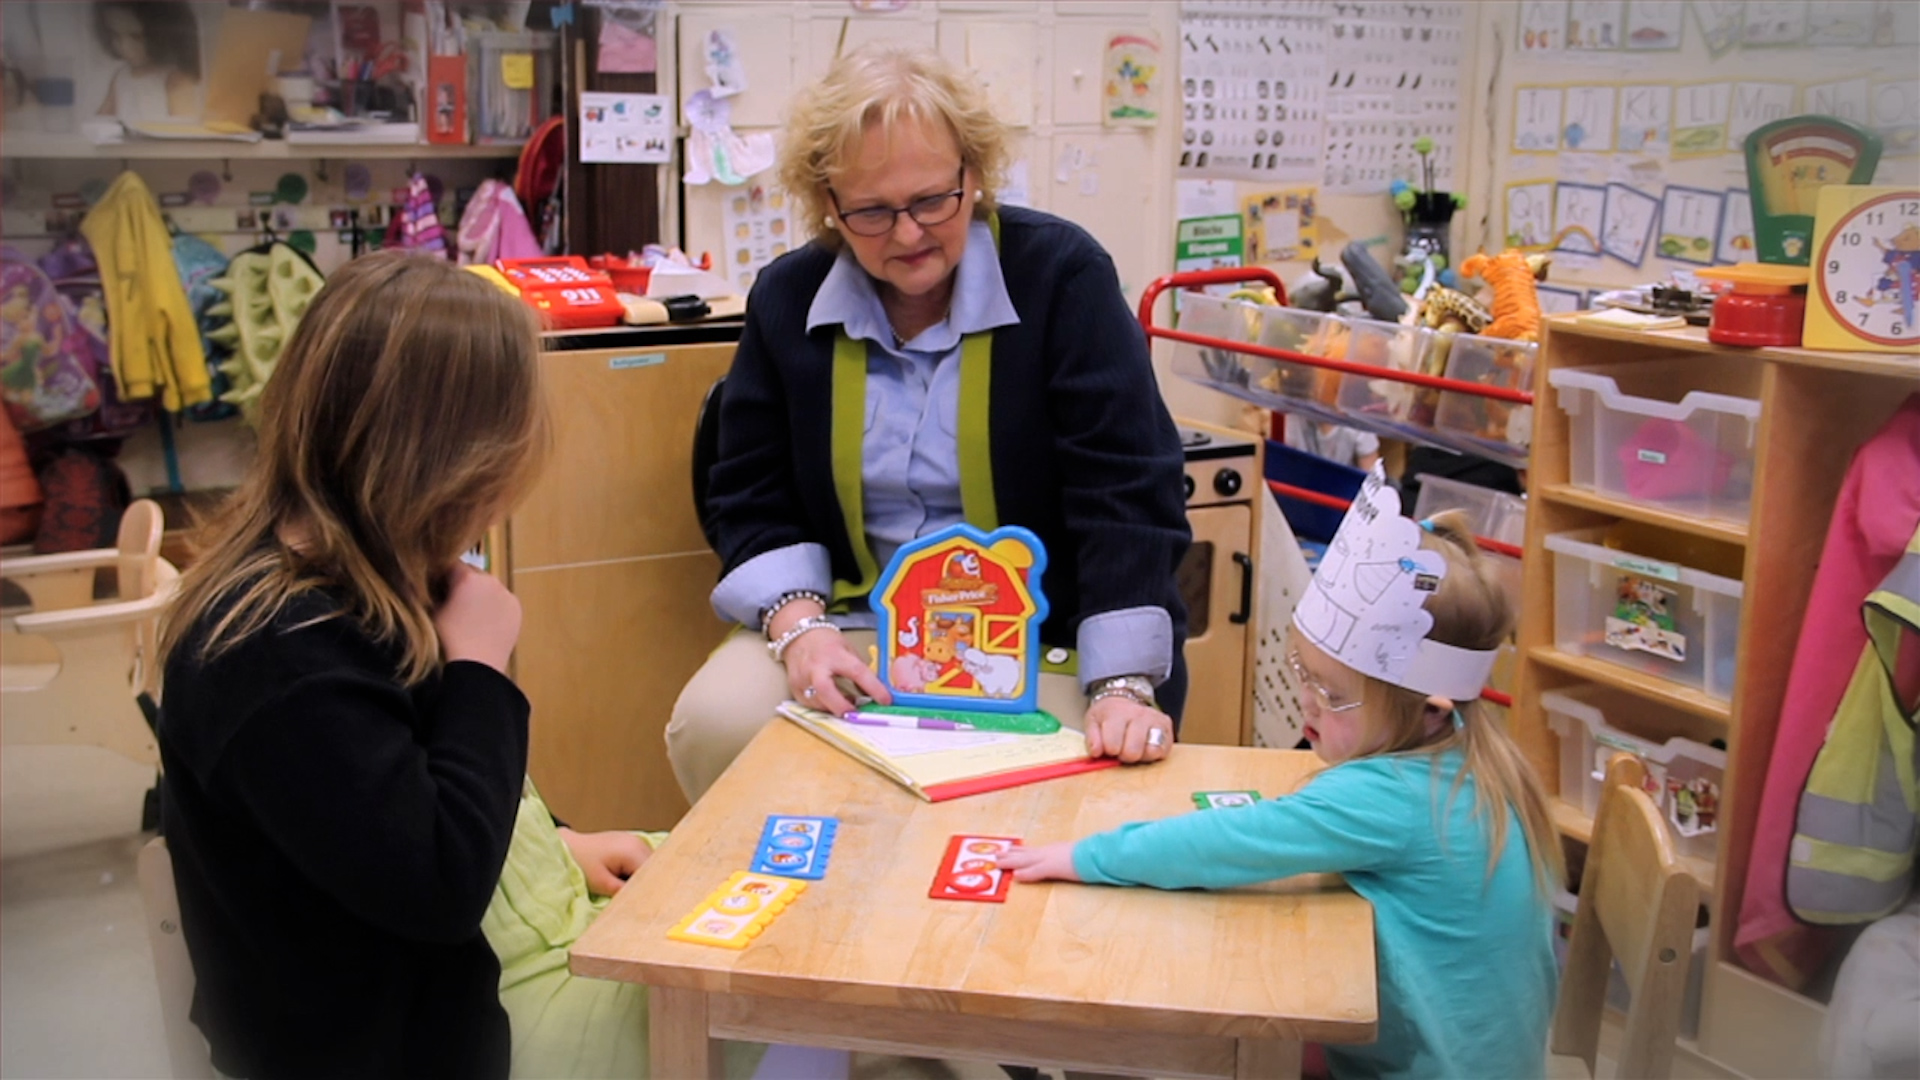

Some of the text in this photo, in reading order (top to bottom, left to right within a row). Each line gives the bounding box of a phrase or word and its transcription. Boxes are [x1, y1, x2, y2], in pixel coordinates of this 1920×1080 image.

[1899, 202, 1919, 216] 12
[1866, 212, 1884, 225] 11
[1841, 232, 1861, 246] 10
[1828, 260, 1840, 274] 9
[561, 288, 602, 301] 911
[1835, 290, 1847, 304] 8
[1858, 313, 1870, 326] 7
[1890, 322, 1902, 335] 6
